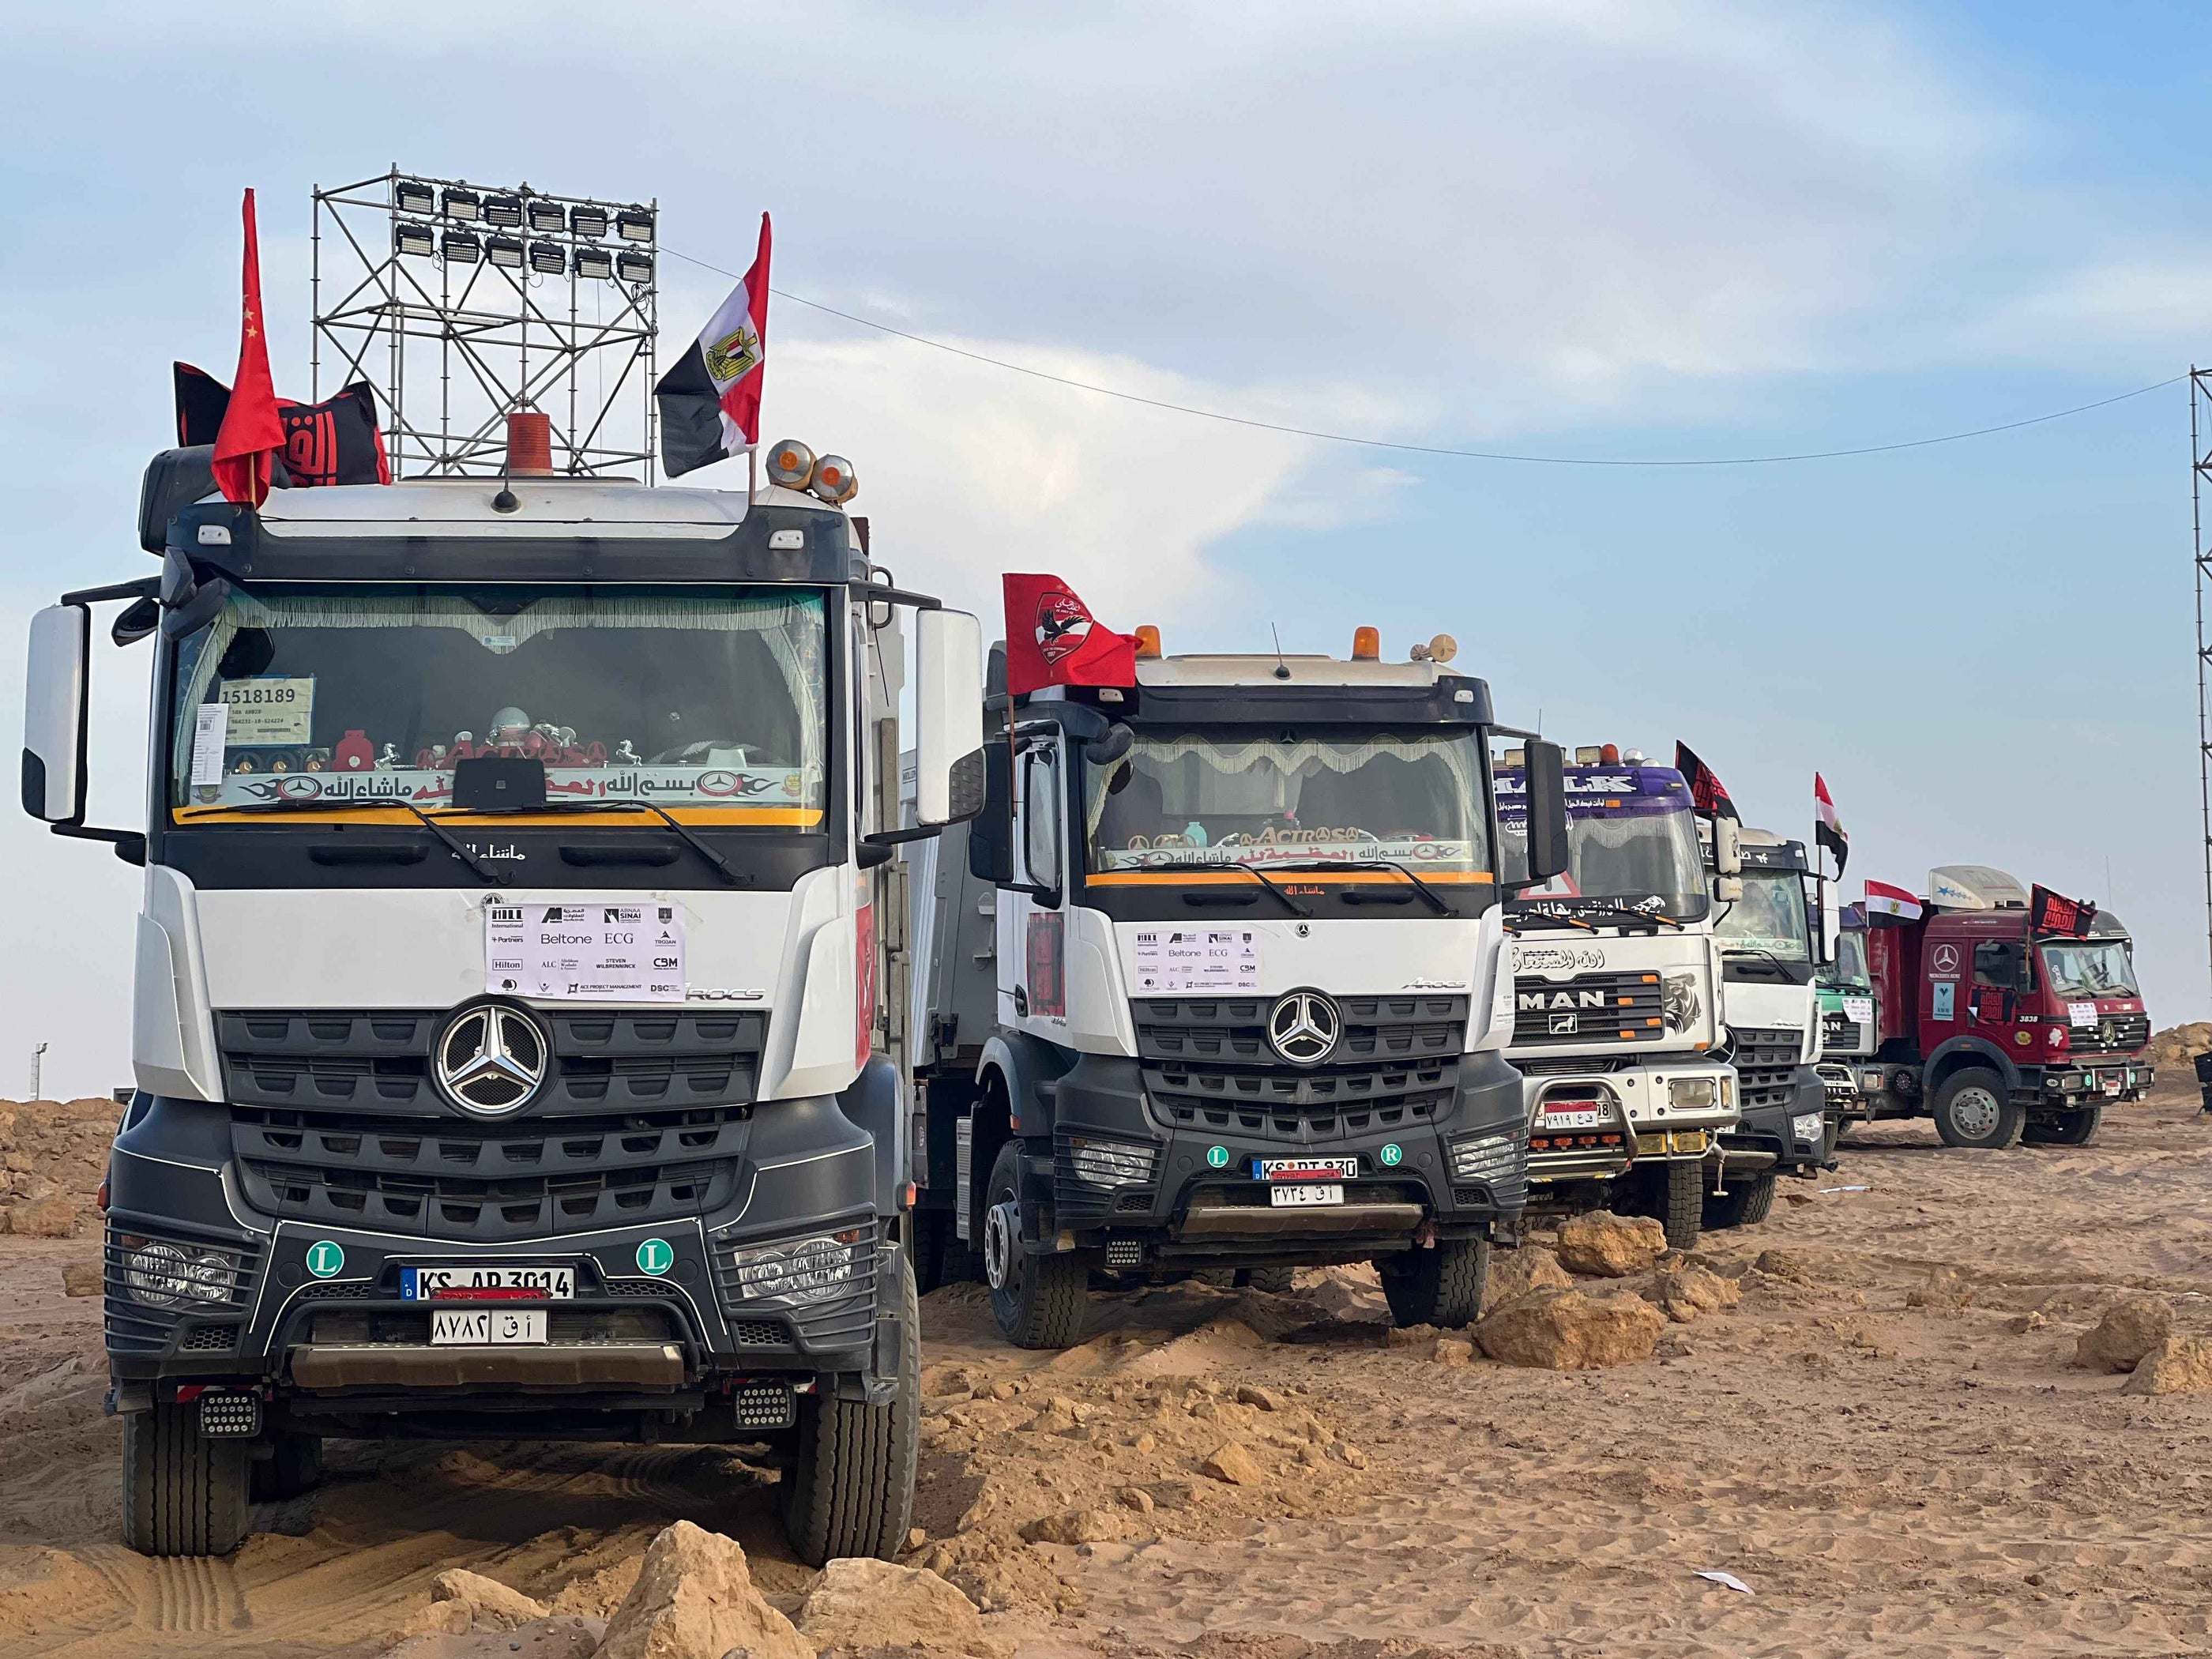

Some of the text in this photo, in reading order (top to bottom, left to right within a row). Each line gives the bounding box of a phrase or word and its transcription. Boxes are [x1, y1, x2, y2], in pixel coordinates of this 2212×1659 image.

[222, 689, 295, 704] 1518189
[324, 775, 412, 799] ماشاء الله
[606, 771, 638, 796] الله
[1359, 845, 1378, 861] الله
[541, 934, 592, 944] Beltone
[604, 933, 634, 944] ECG
[653, 957, 678, 967] CBM
[685, 982, 766, 1000] ROCS
[1518, 991, 1605, 1010] MAN
[1214, 1151, 1227, 1165] L
[1386, 1149, 1398, 1162] R
[315, 1247, 338, 1273] L
[645, 1245, 667, 1270] L
[435, 1315, 487, 1338] ٨٧٨٢
